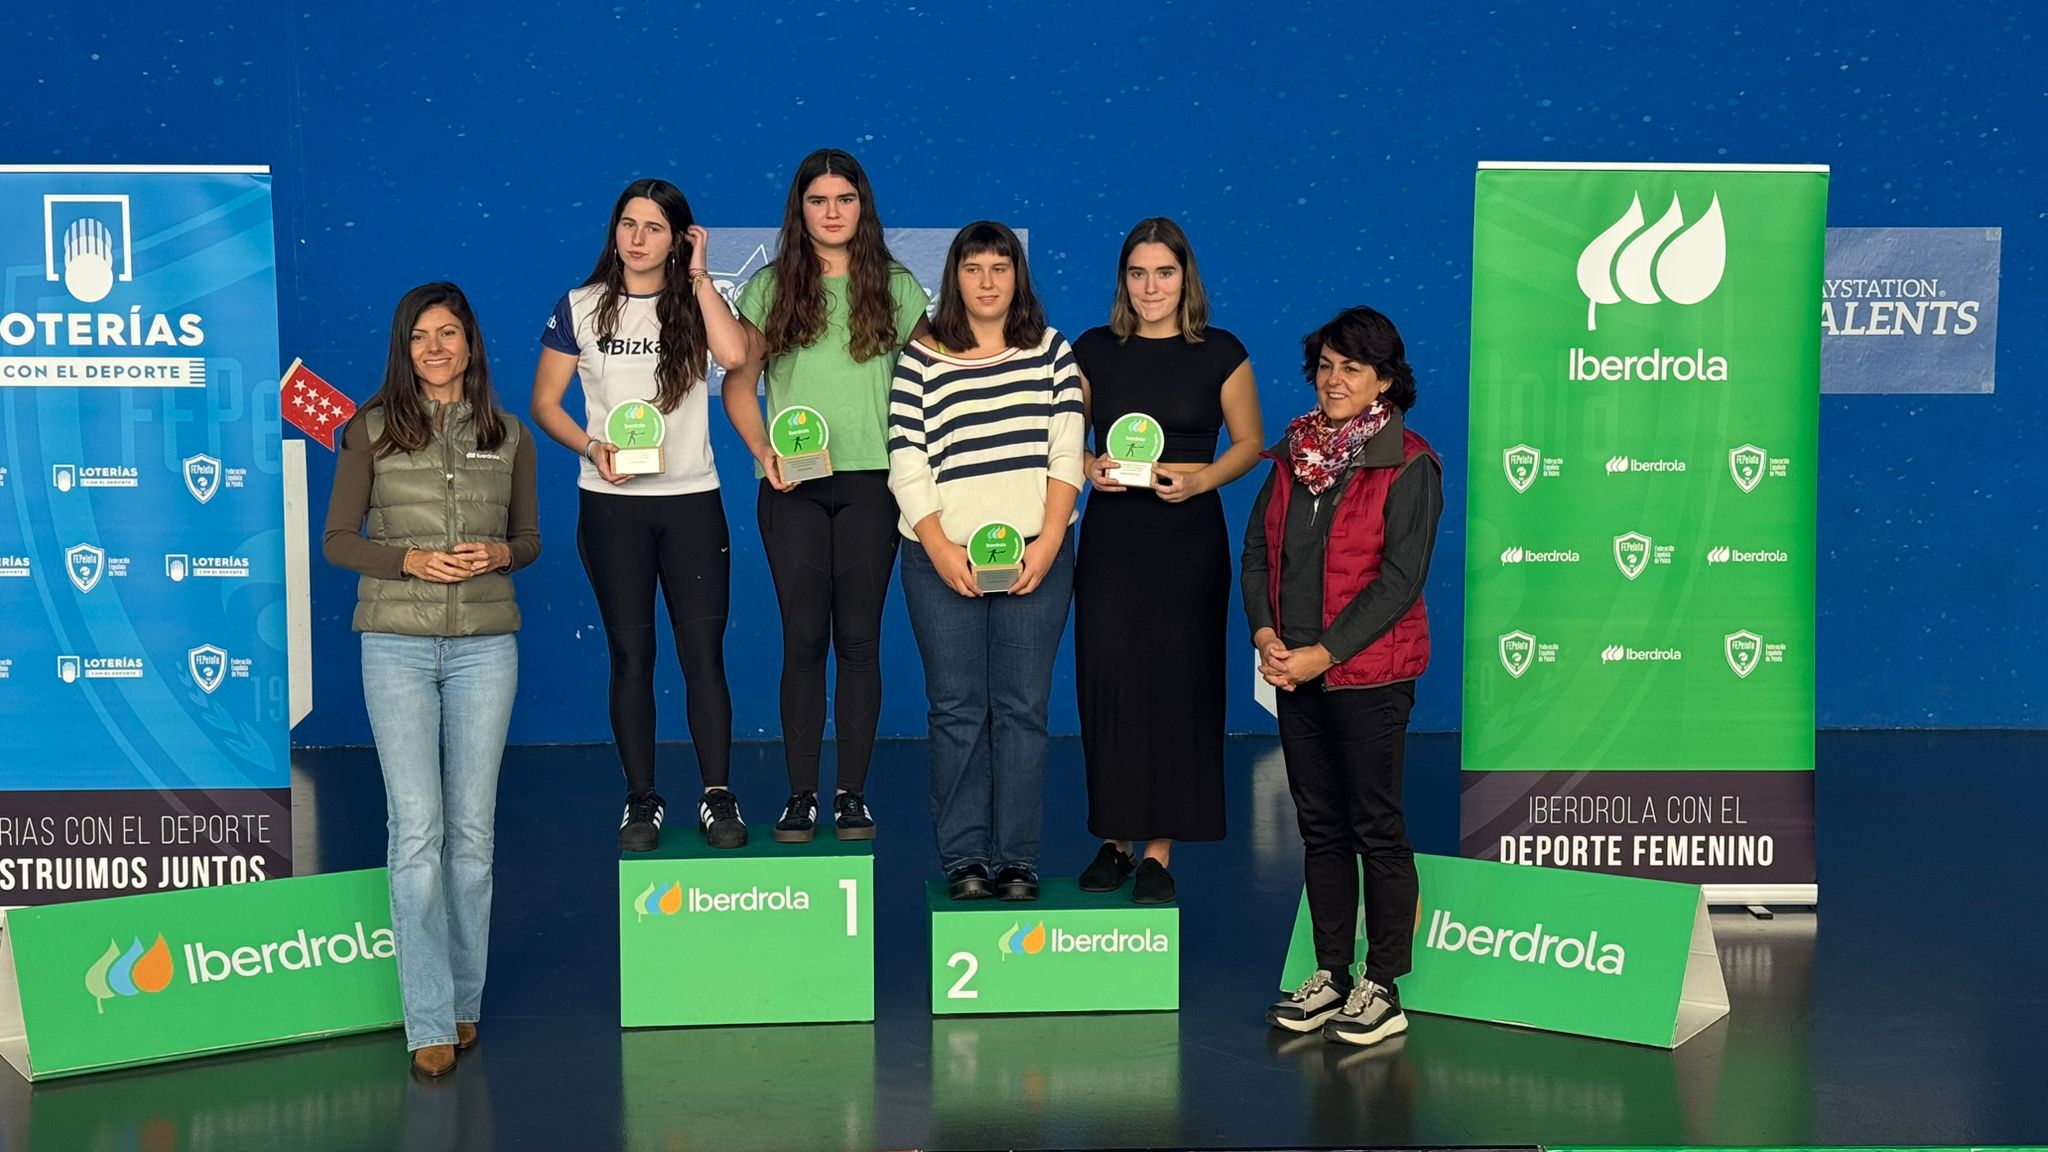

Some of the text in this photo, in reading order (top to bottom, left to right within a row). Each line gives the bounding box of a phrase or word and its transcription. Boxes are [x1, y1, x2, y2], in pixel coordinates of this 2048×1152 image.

[4, 365, 180, 379] CON EL DEPORTE
[1569, 348, 1728, 381] Iberdrola
[80, 465, 138, 477] LOTERÍAS
[1631, 458, 1686, 472] Iberdrola
[0, 555, 30, 566] RÍAS
[192, 556, 250, 566] LOTERÍAS
[1525, 549, 1580, 562] Iberdrola
[1732, 549, 1788, 562] Iberdrola
[84, 656, 144, 668] LOTERÍAS
[1626, 648, 1681, 660] Iberdrola
[1529, 796, 1748, 824] IBERDROLA CON EL
[65, 816, 112, 846] CON
[123, 816, 150, 844] EL
[161, 815, 271, 844] DEPORTE
[1500, 835, 1774, 866] DEPORTE FEMENINO
[158, 856, 266, 888] JUNTOS
[688, 879, 858, 936] Iberdrola 1
[184, 921, 397, 984] Iberdrola
[1051, 928, 1168, 954] Iberdrola
[1426, 909, 1626, 976] Iberdrola
[946, 951, 978, 999] 2
